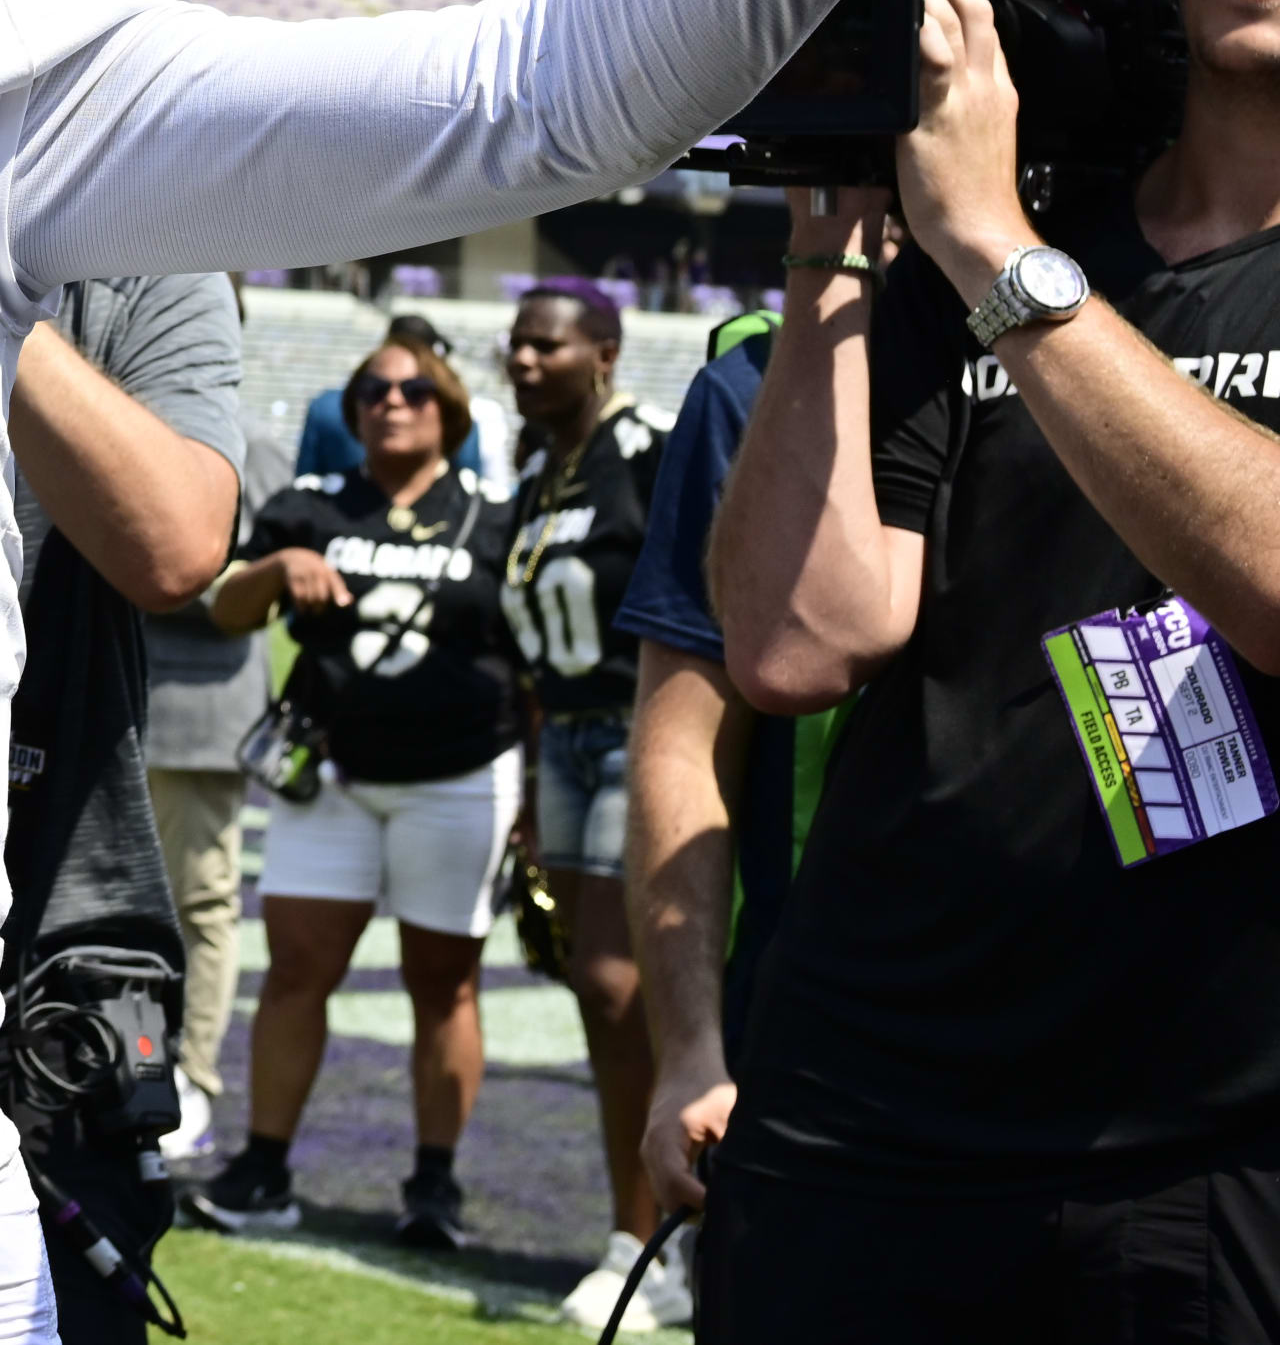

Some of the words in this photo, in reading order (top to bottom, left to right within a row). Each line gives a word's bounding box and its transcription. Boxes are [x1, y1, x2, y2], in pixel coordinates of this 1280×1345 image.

[1155, 599, 1192, 650] TCU
[1110, 670, 1130, 690] PB
[1177, 682, 1194, 707] SEPT
[1184, 665, 1213, 725] COLORADO
[1125, 706, 1144, 727] TA
[1080, 710, 1102, 744] FIELD
[1091, 743, 1117, 789] ACCESS
[1214, 740, 1236, 785] FOWLER
[1226, 735, 1247, 779] TANNER
